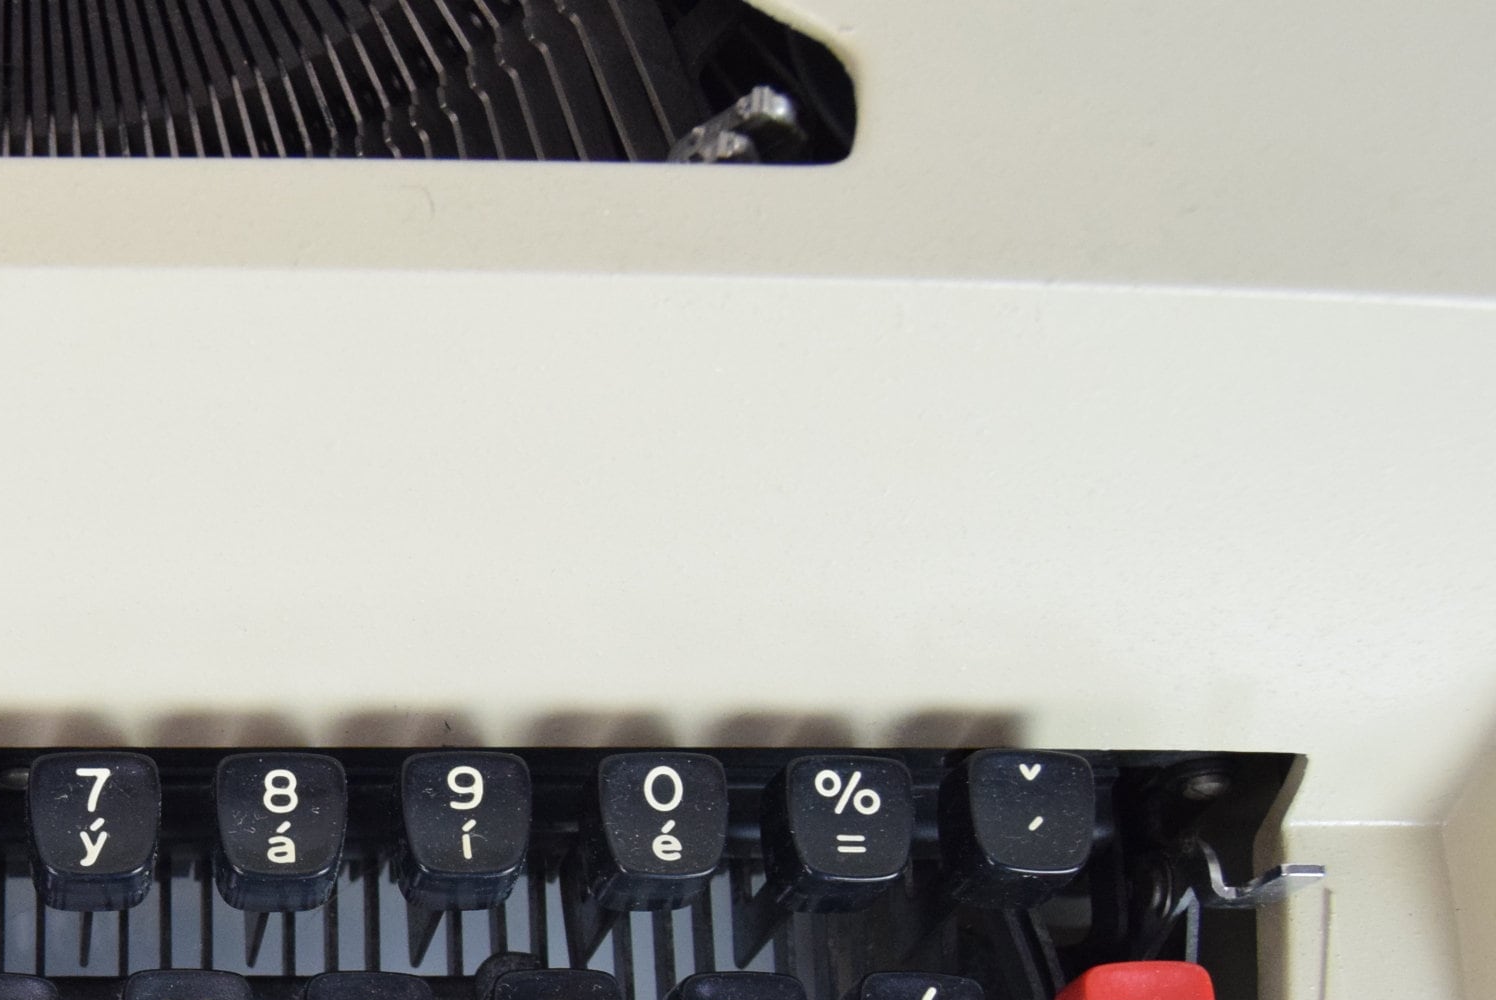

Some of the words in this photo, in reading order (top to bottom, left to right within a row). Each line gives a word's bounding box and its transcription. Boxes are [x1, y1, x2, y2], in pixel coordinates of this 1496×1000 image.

[75, 767, 111, 812] 7
[262, 768, 299, 814] 8
[447, 766, 484, 811] 9
[814, 769, 882, 815] %
[79, 817, 108, 866] ý
[267, 820, 297, 864] á
[651, 819, 683, 861] é
[836, 833, 868, 854] =
